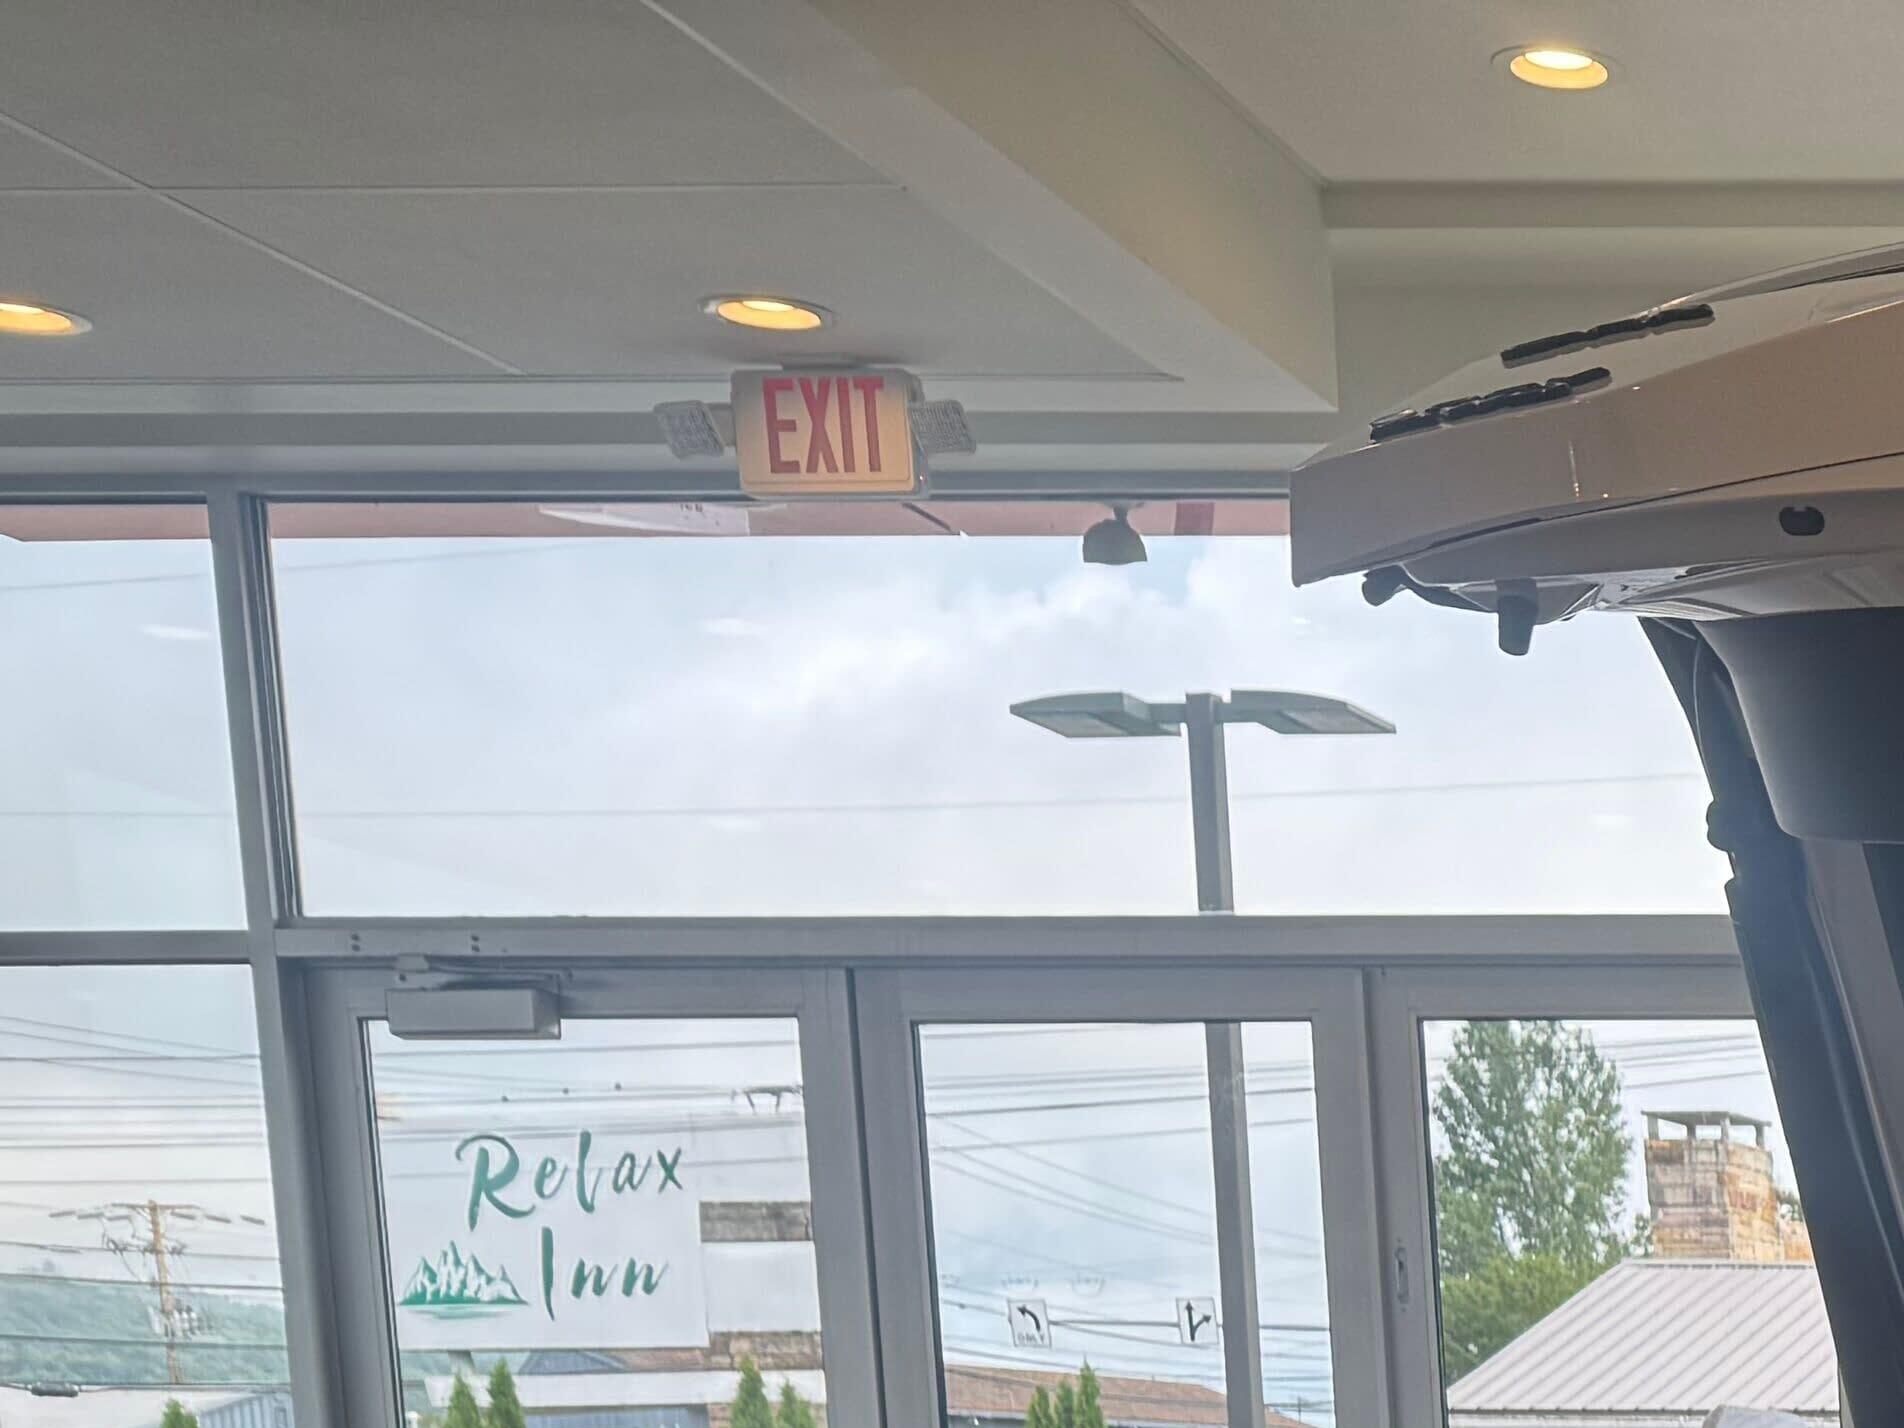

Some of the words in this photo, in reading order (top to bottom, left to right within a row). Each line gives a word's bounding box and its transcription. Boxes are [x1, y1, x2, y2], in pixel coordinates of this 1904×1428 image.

[762, 376, 885, 474] EXIT
[455, 1130, 683, 1232] Relax
[541, 1226, 670, 1320] Inn
